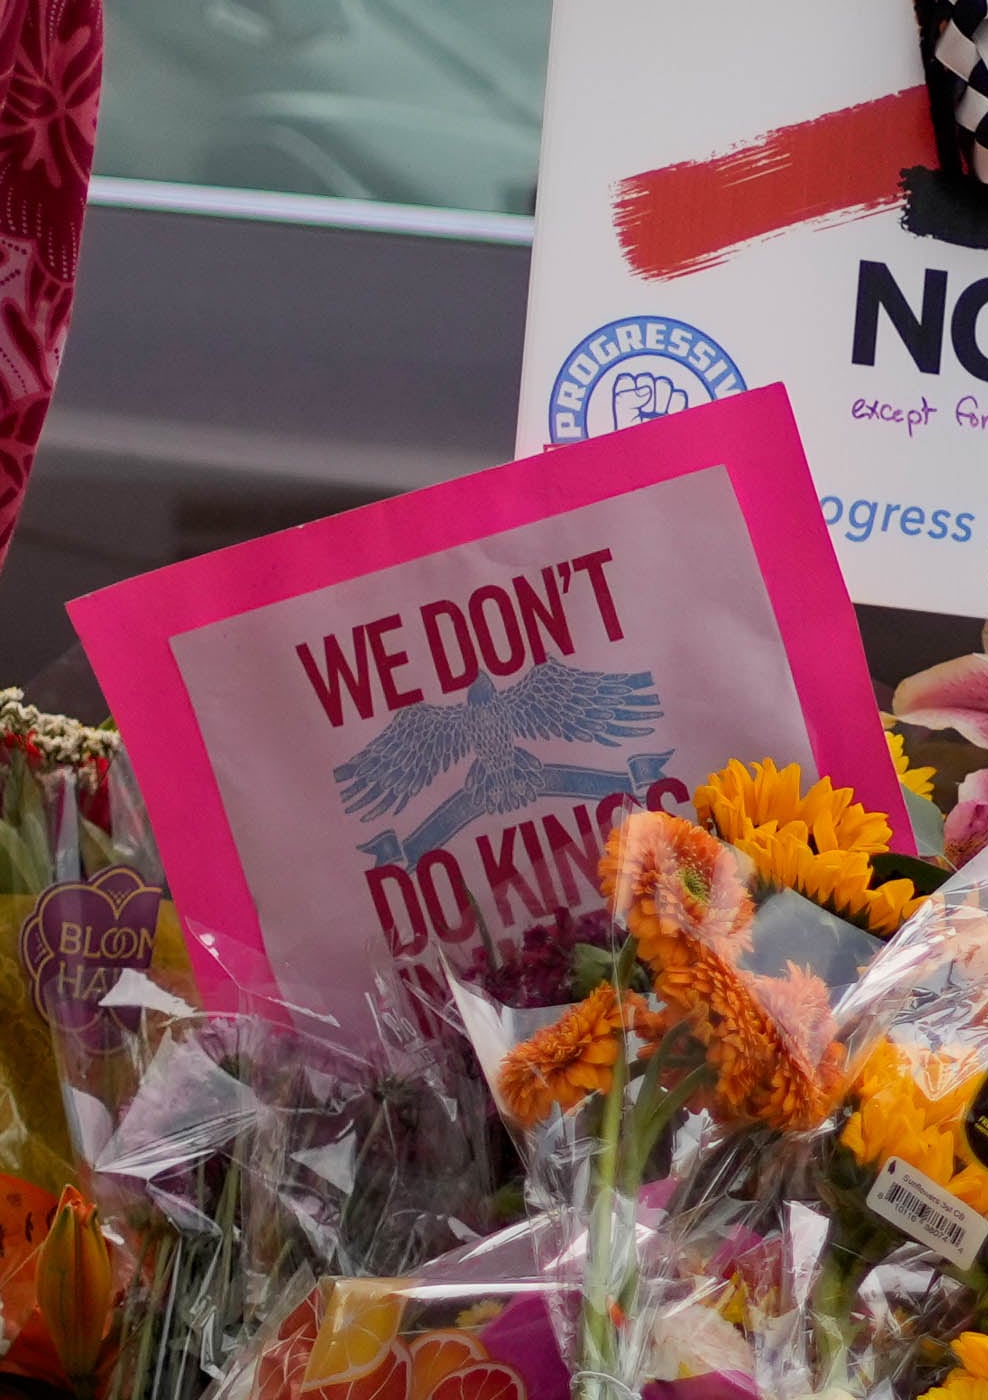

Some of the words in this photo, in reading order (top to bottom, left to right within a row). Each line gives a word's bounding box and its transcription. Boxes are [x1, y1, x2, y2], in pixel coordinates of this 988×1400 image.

[555, 322, 742, 440] PROGRESSIV
[851, 396, 938, 437] except
[820, 495, 975, 542] ogress
[295, 612, 424, 728] WE
[420, 547, 625, 695] DON'T
[365, 848, 476, 960] DO
